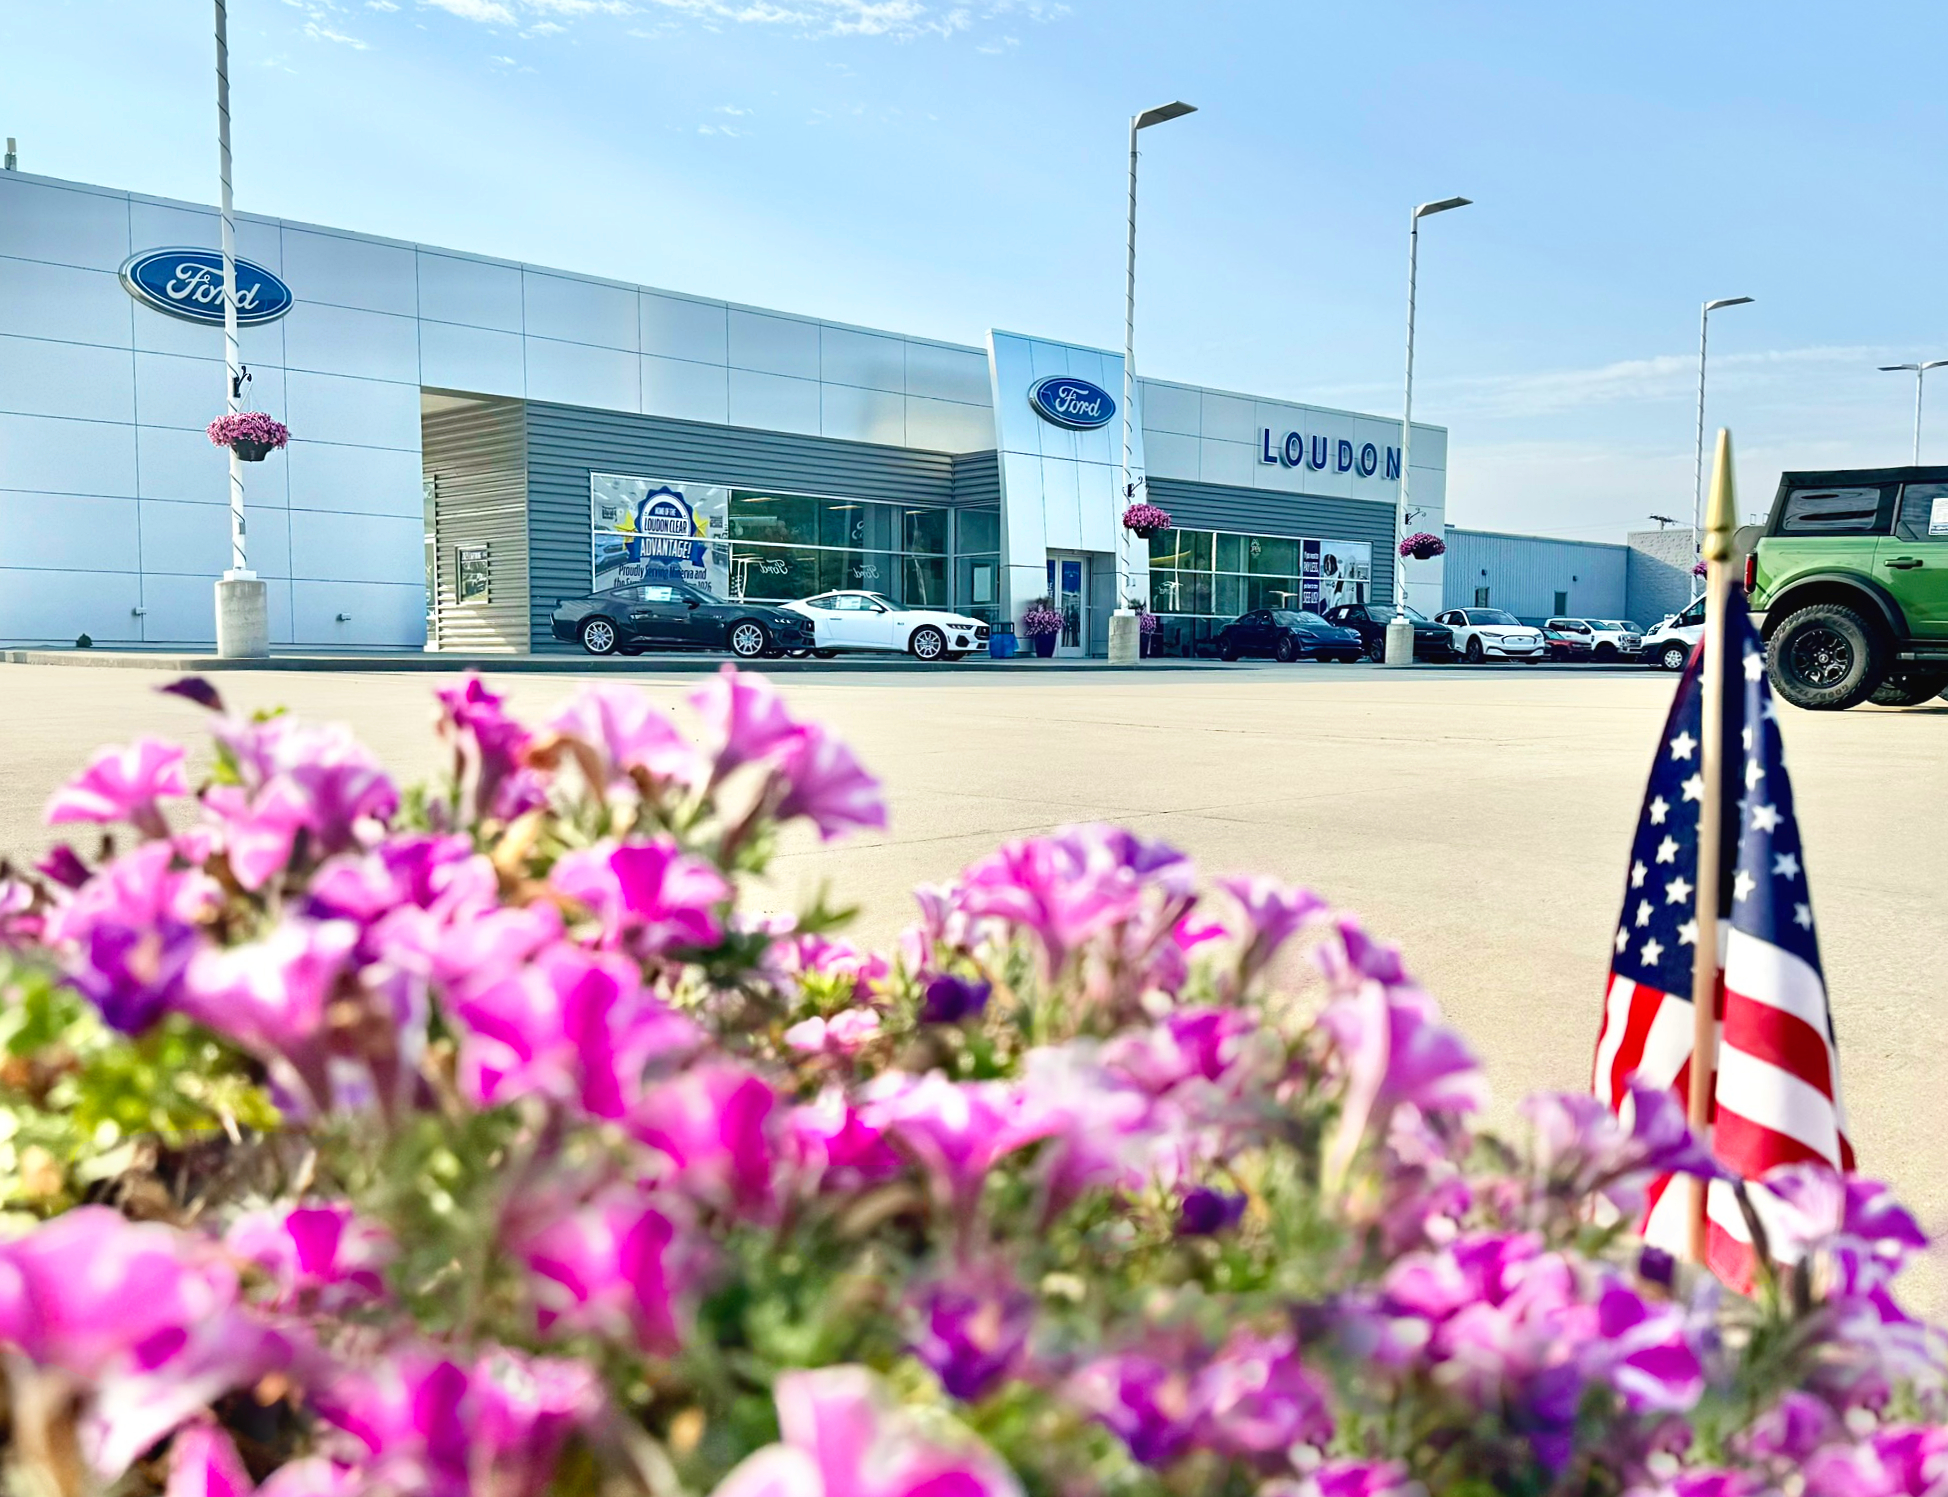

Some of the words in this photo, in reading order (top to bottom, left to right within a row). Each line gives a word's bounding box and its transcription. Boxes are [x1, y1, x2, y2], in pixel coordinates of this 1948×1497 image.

[166, 262, 261, 310] Ford
[1055, 385, 1101, 417] Ford
[1261, 428, 1401, 480] LOUDON
[644, 517, 669, 532] LOUDON
[669, 519, 688, 534] CLEAR
[640, 538, 692, 559] ADVANTAGE!
[618, 564, 645, 578] Proudly
[645, 565, 668, 580] Serving
[669, 566, 693, 579] Minerva
[695, 568, 706, 580] and
